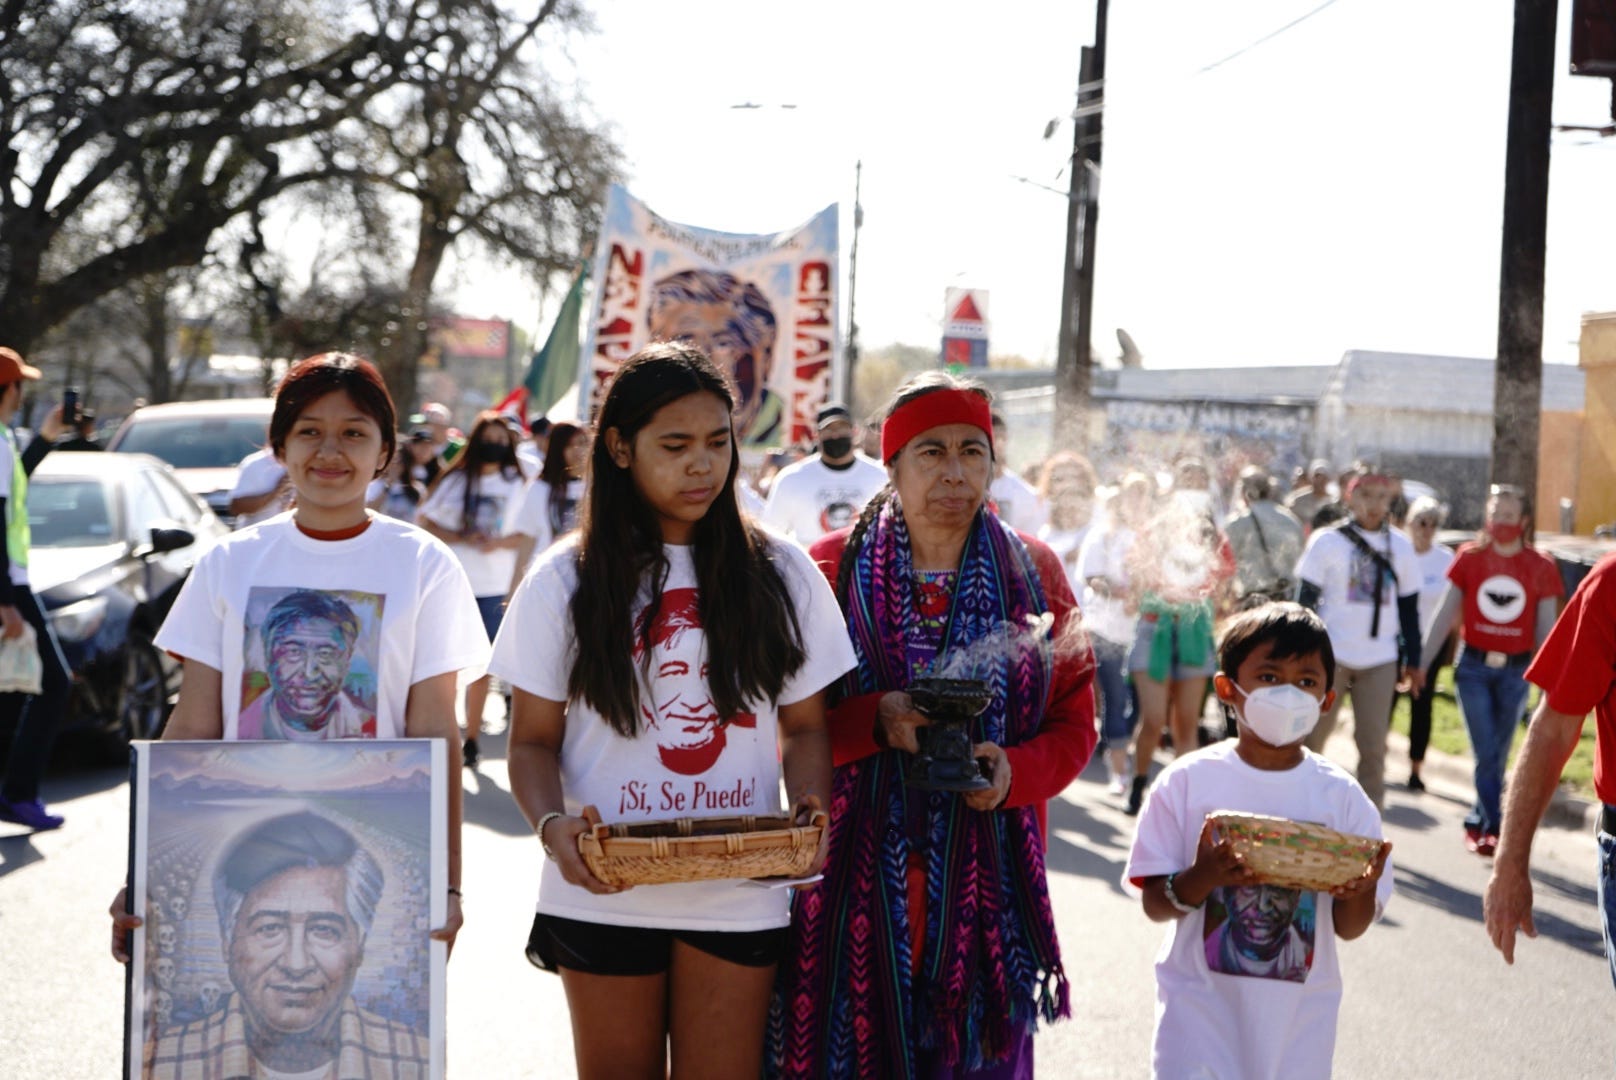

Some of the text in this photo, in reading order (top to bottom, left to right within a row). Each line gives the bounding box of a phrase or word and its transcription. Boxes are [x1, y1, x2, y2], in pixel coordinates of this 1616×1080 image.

[619, 777, 756, 815] ¡Sí, Se Puede!
